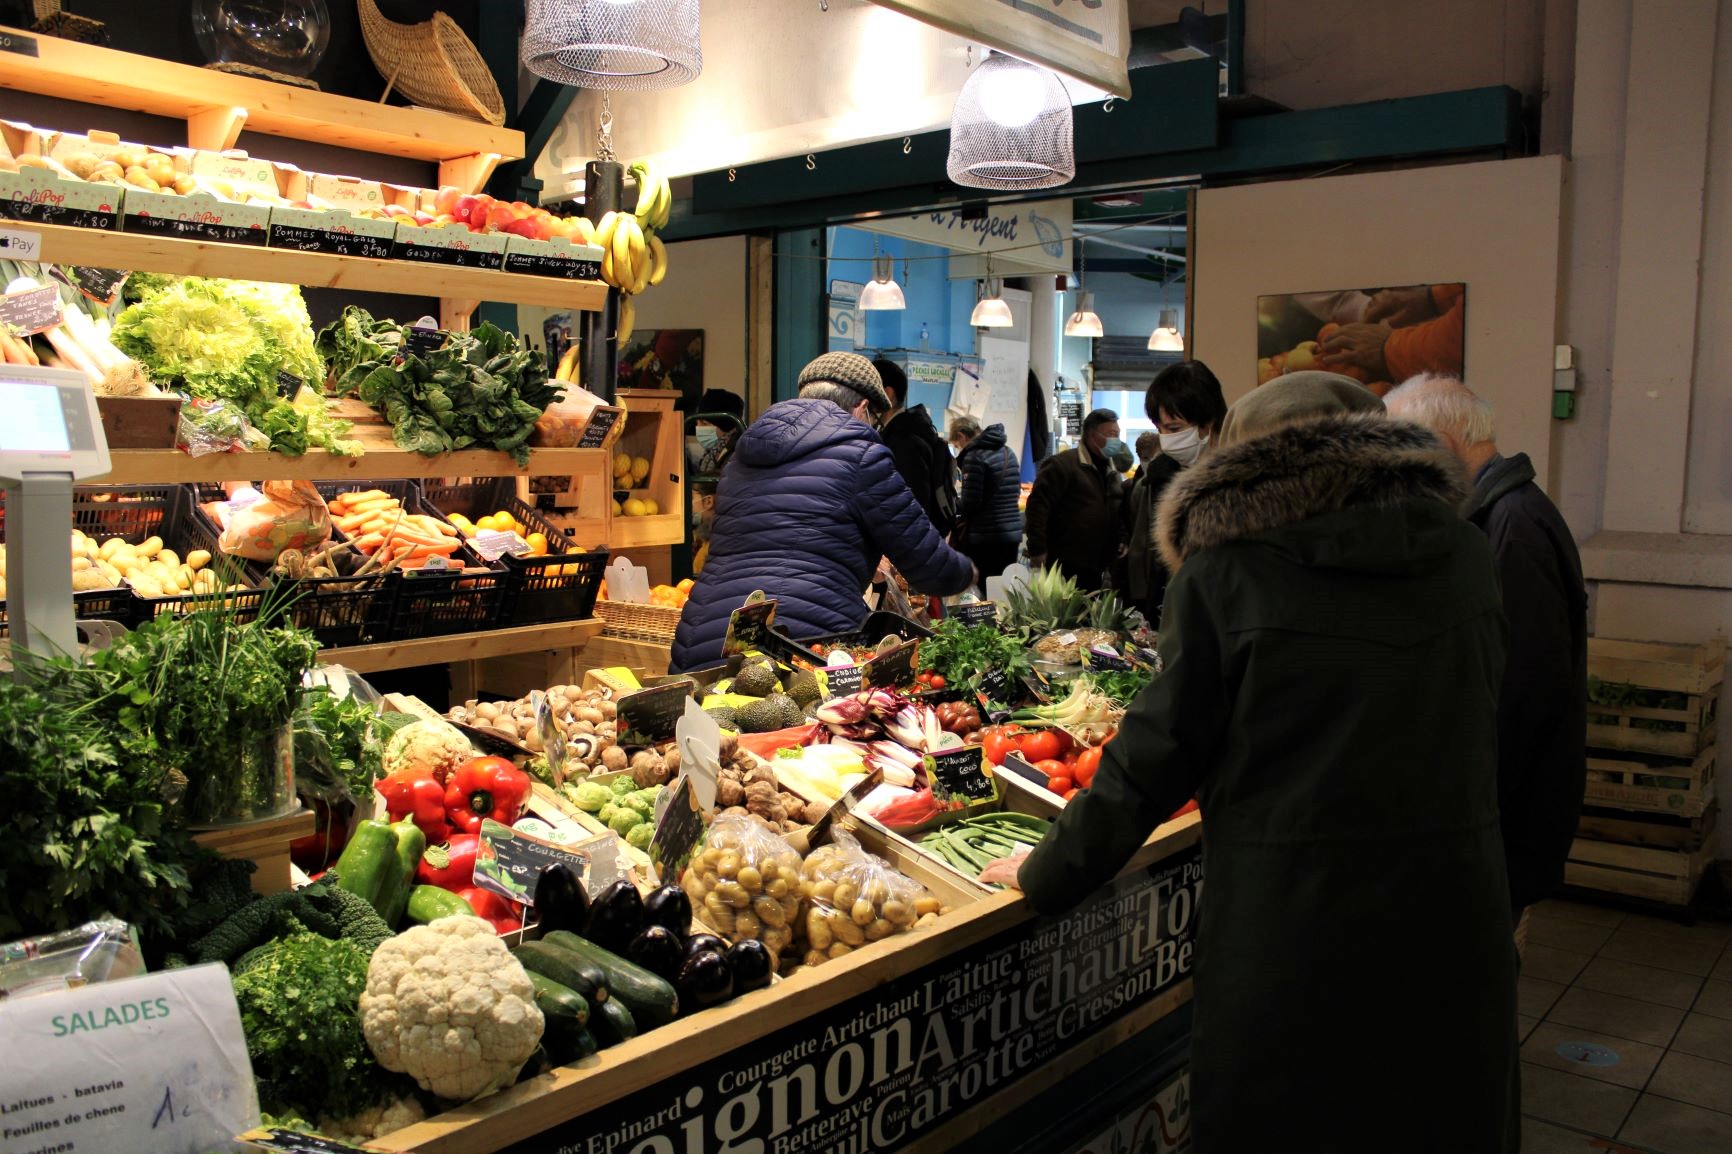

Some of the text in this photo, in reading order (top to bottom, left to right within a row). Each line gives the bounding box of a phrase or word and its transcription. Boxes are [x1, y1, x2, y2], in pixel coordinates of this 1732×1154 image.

[12, 237, 35, 254] Pay
[275, 225, 315, 238] POMMES
[406, 249, 443, 261] GOLDEN
[1019, 929, 1058, 961] Bette
[1057, 894, 1136, 949] Pâtisson
[909, 918, 1149, 1088] Artichaut
[922, 952, 1014, 1018] Laitue
[1056, 968, 1152, 1041] Cresson
[51, 997, 170, 1037] SALADES
[820, 988, 921, 1053] Artichaut
[717, 1037, 819, 1095] Courgette
[871, 1032, 1035, 1149] Carotte
[1, 1094, 55, 1115] Laitues
[75, 1079, 125, 1098] batavia
[3, 1103, 126, 1140] Feuilles de chene
[586, 1096, 682, 1154] Epinard
[772, 1095, 874, 1154] Betterave
